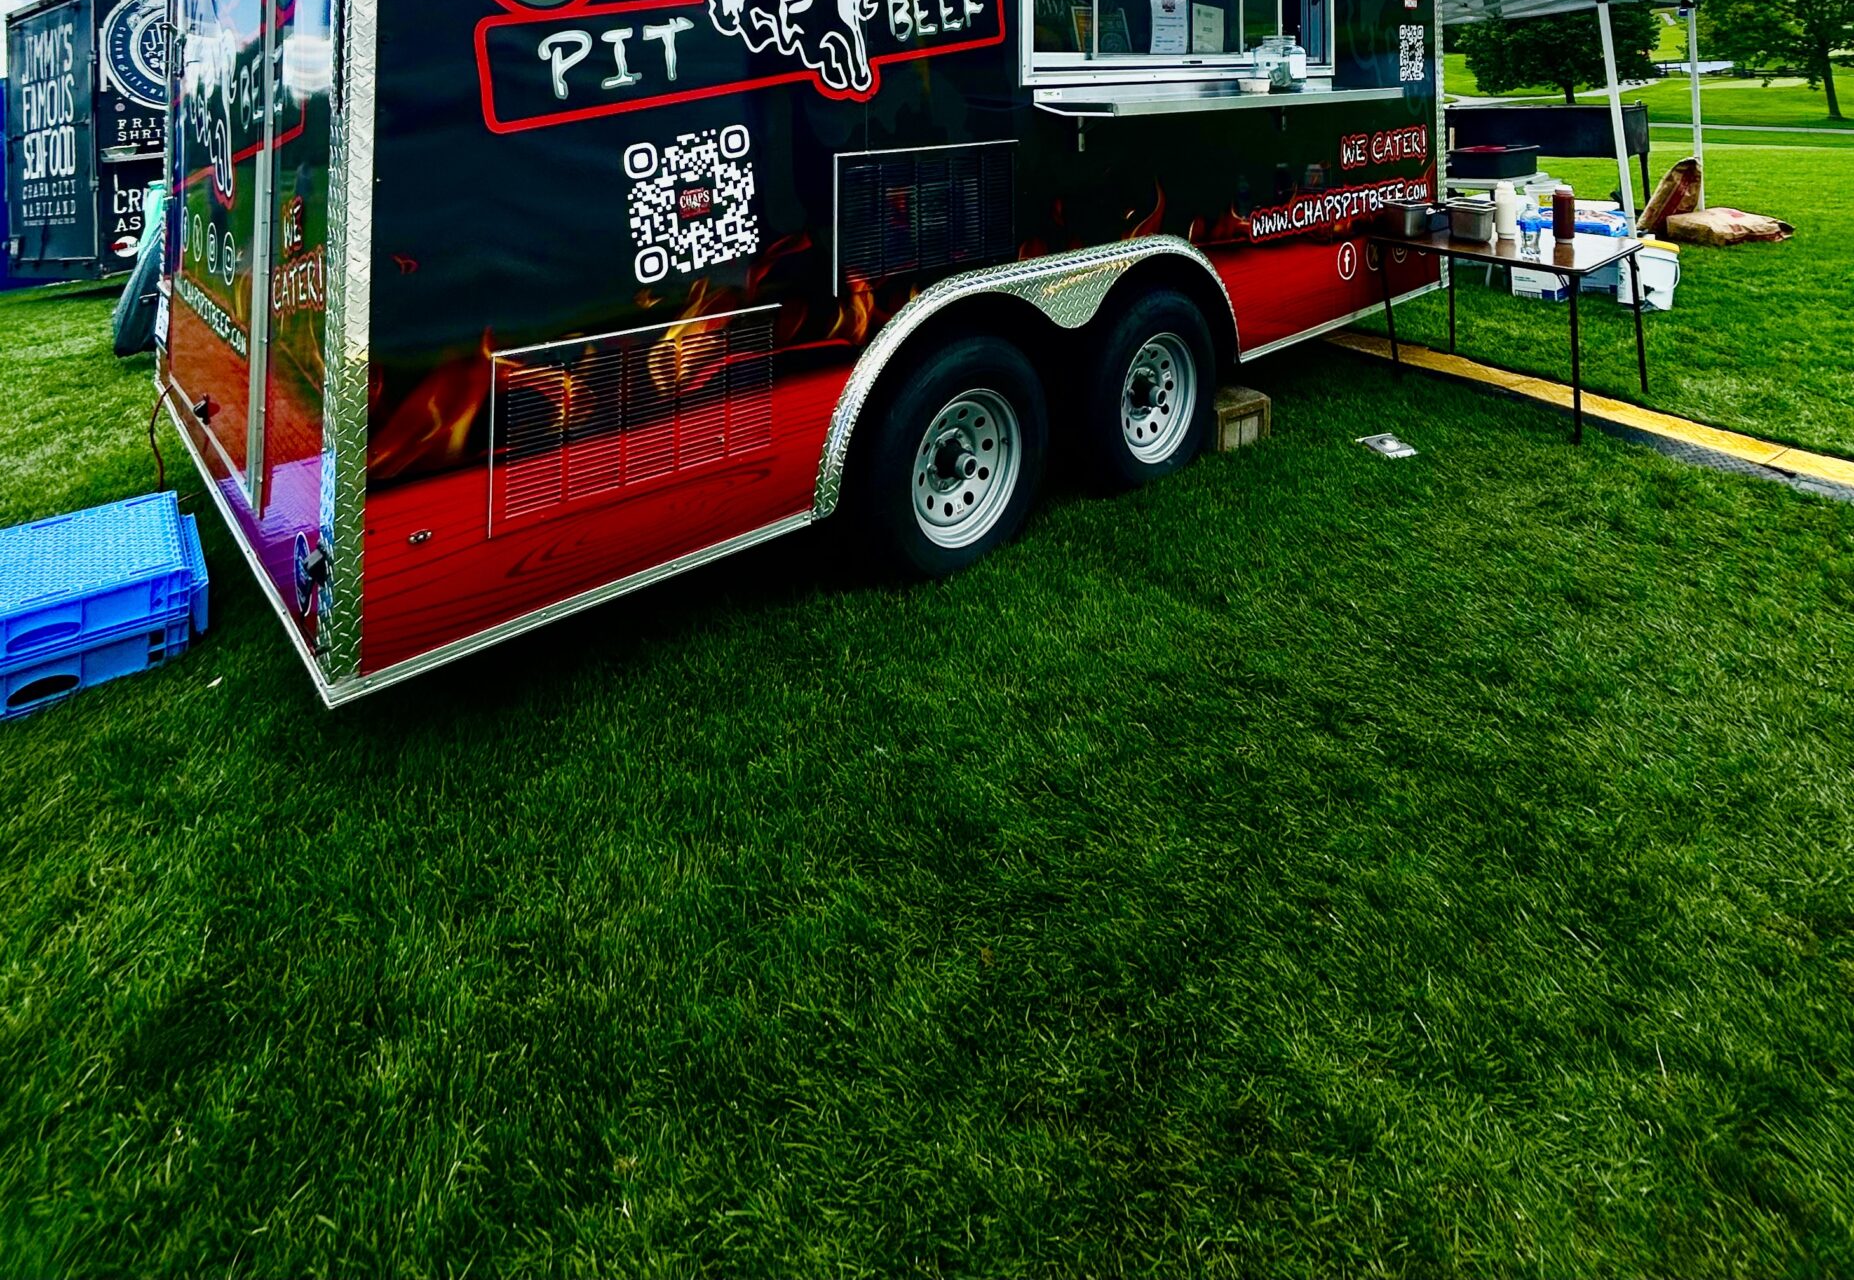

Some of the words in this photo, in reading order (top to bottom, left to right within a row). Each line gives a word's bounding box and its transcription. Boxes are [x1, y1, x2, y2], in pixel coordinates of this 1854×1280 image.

[22, 22, 74, 85] JIMMY'S
[537, 17, 695, 99] PIT
[22, 73, 75, 132] FAMOUS
[23, 125, 76, 180] SEAFOOD
[1343, 139, 1366, 165] WE
[1372, 130, 1427, 160] CATER!
[283, 204, 301, 250] WE
[680, 190, 710, 208] CHAPS
[272, 252, 324, 311] CATER!
